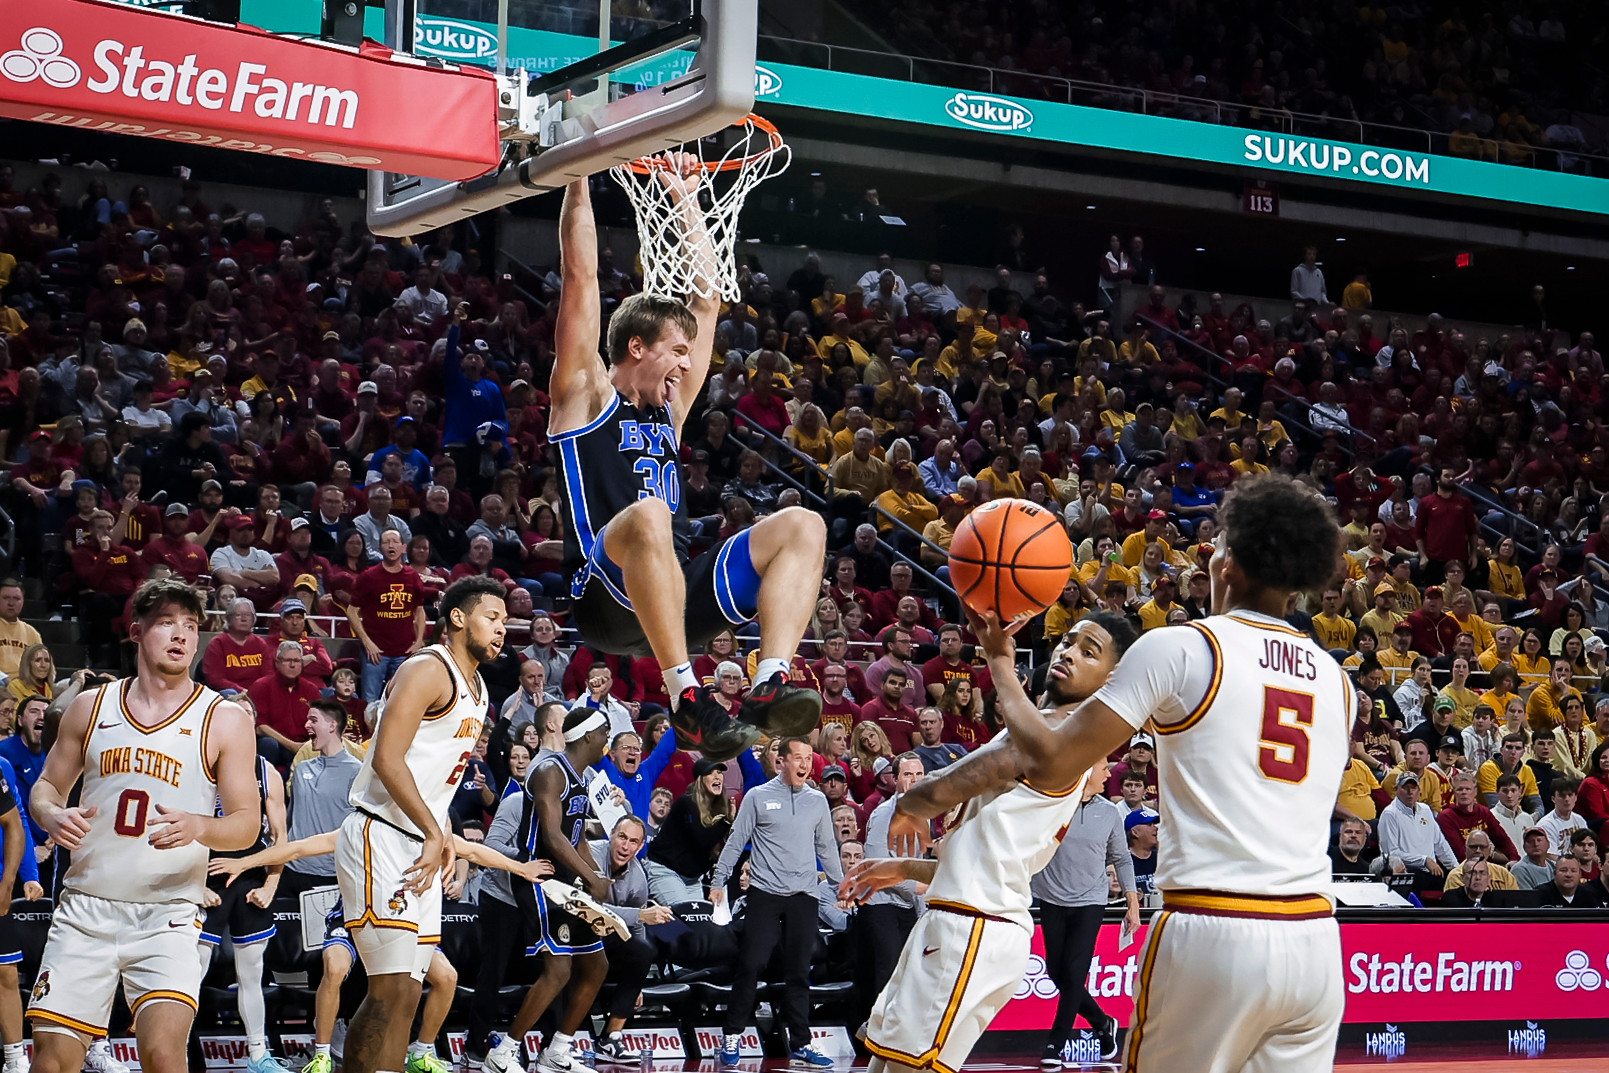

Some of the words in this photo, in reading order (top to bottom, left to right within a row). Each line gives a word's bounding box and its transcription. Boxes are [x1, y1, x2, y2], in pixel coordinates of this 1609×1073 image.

[954, 92, 1025, 130] Sukup
[1243, 133, 1430, 184] SUKUP.COM
[1250, 195, 1273, 212] 113
[633, 456, 680, 514] 30
[1259, 638, 1317, 681] JONES
[1258, 684, 1316, 785] 5
[100, 747, 131, 777] IOWA
[134, 747, 183, 789] STATE
[595, 784, 610, 806] BYU
[114, 788, 150, 838] 0
[441, 914, 476, 923] OETRY
[1063, 1039, 1101, 1051] ANDUS
[1366, 1032, 1406, 1046] LANDUS
[1508, 1029, 1546, 1044] LANDUS
[203, 1040, 250, 1065] HyV
